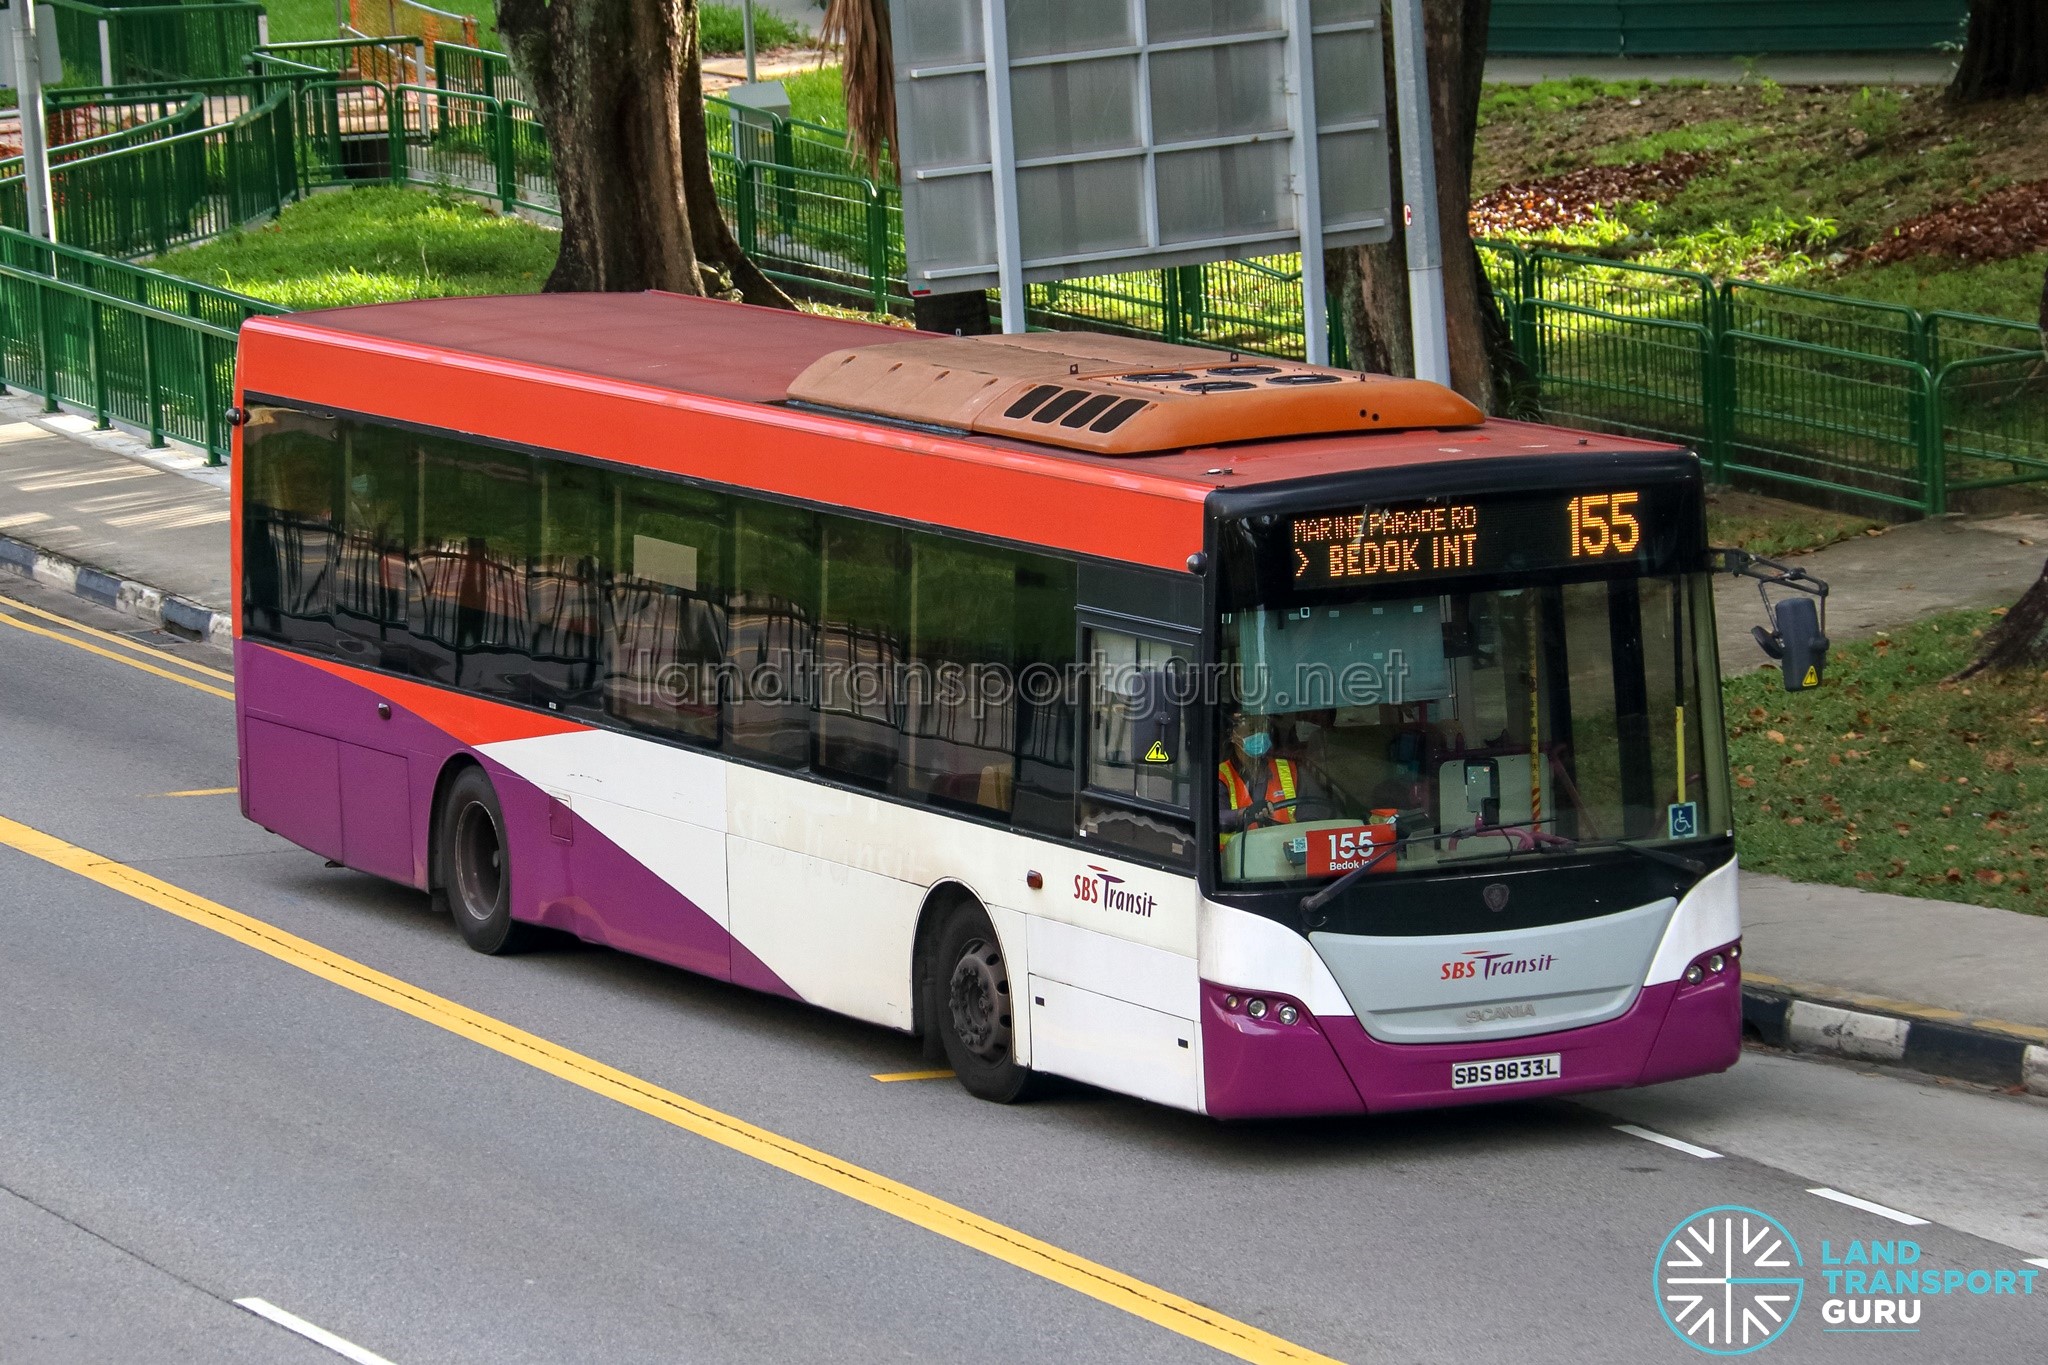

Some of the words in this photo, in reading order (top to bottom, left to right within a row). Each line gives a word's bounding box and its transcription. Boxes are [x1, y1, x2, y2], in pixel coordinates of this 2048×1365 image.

[1294, 516, 1365, 543] MARINE
[1369, 507, 1446, 537] PARADE
[1451, 505, 1477, 530] RD
[1567, 492, 1640, 557] 155
[1329, 538, 1420, 577] BEDOK
[1432, 533, 1477, 569] INT
[1328, 831, 1375, 860] 155
[1329, 860, 1359, 871] Bedok
[1073, 874, 1098, 904] SBS
[1096, 873, 1158, 918] Transit
[1440, 961, 1476, 981] SBS
[1474, 952, 1560, 981] Transit
[1465, 1003, 1537, 1024] SCANIA
[1454, 1058, 1558, 1085] SBS8833L
